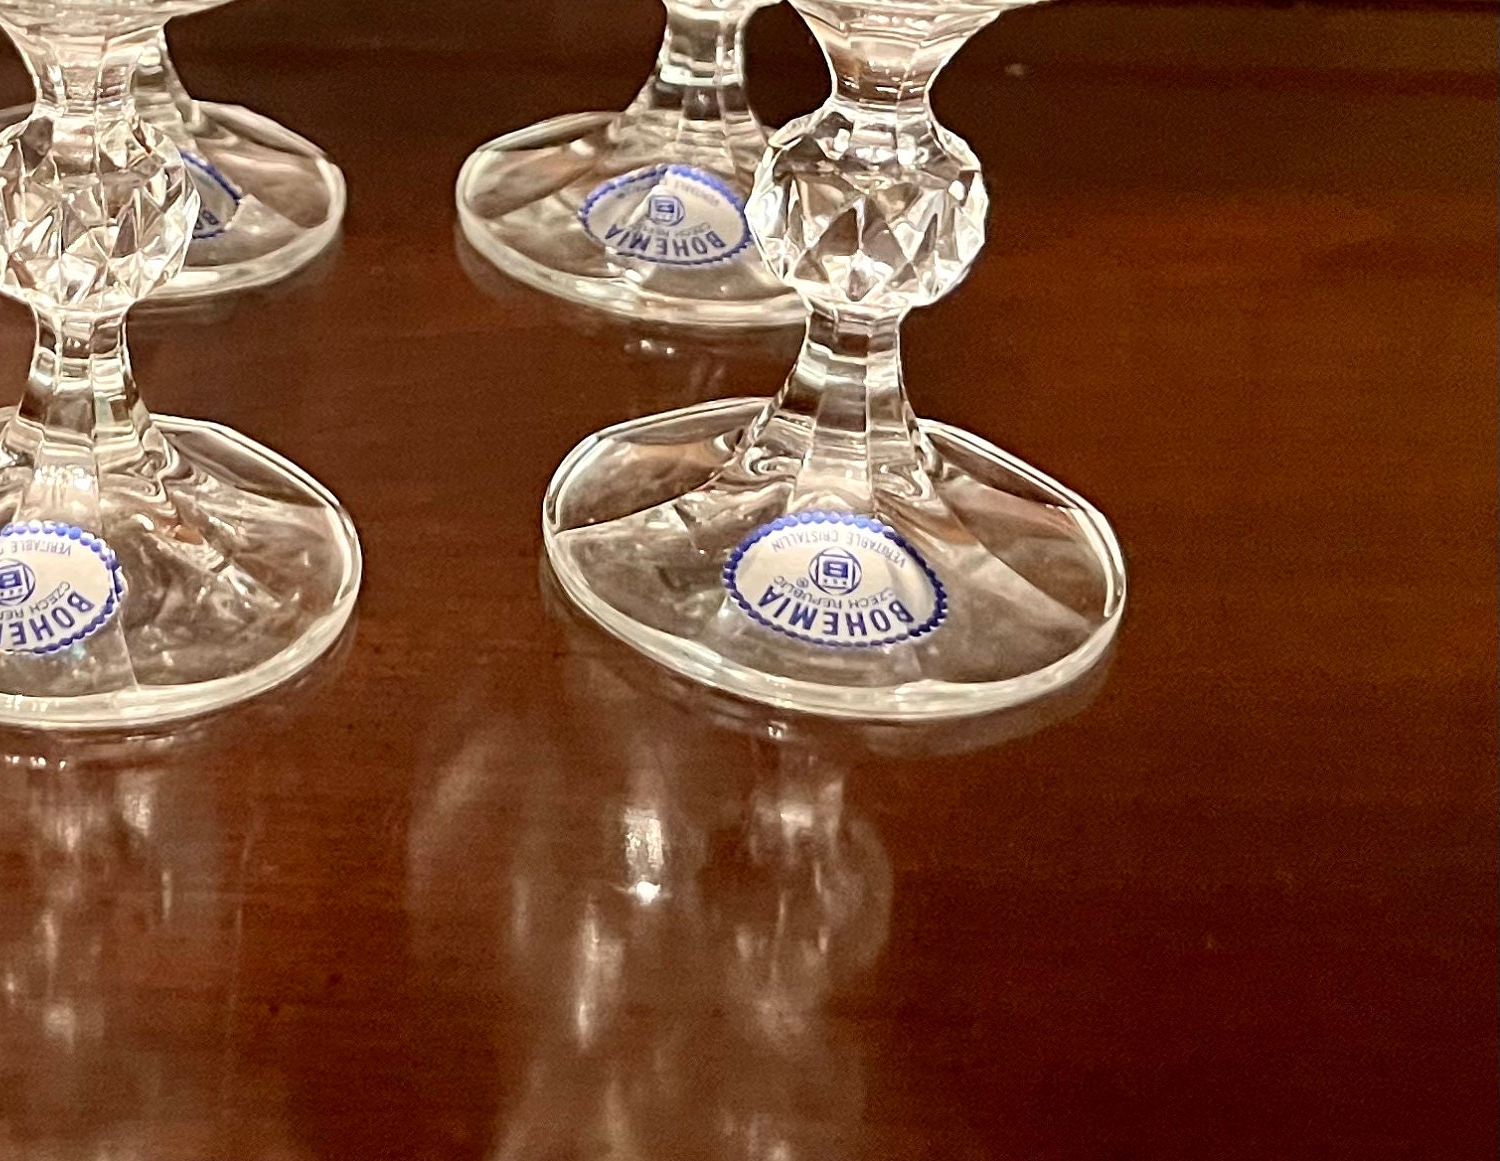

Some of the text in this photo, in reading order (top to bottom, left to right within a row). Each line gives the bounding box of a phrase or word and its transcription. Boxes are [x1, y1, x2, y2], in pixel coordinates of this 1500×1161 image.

[605, 223, 726, 257] BOHEMIA
[771, 529, 908, 568] VERITABLE CRISTALLIN
[23, 580, 71, 620] CZECH
[758, 585, 914, 637] BOHEMIA
[773, 575, 896, 610] CZECH REPUBLIC
